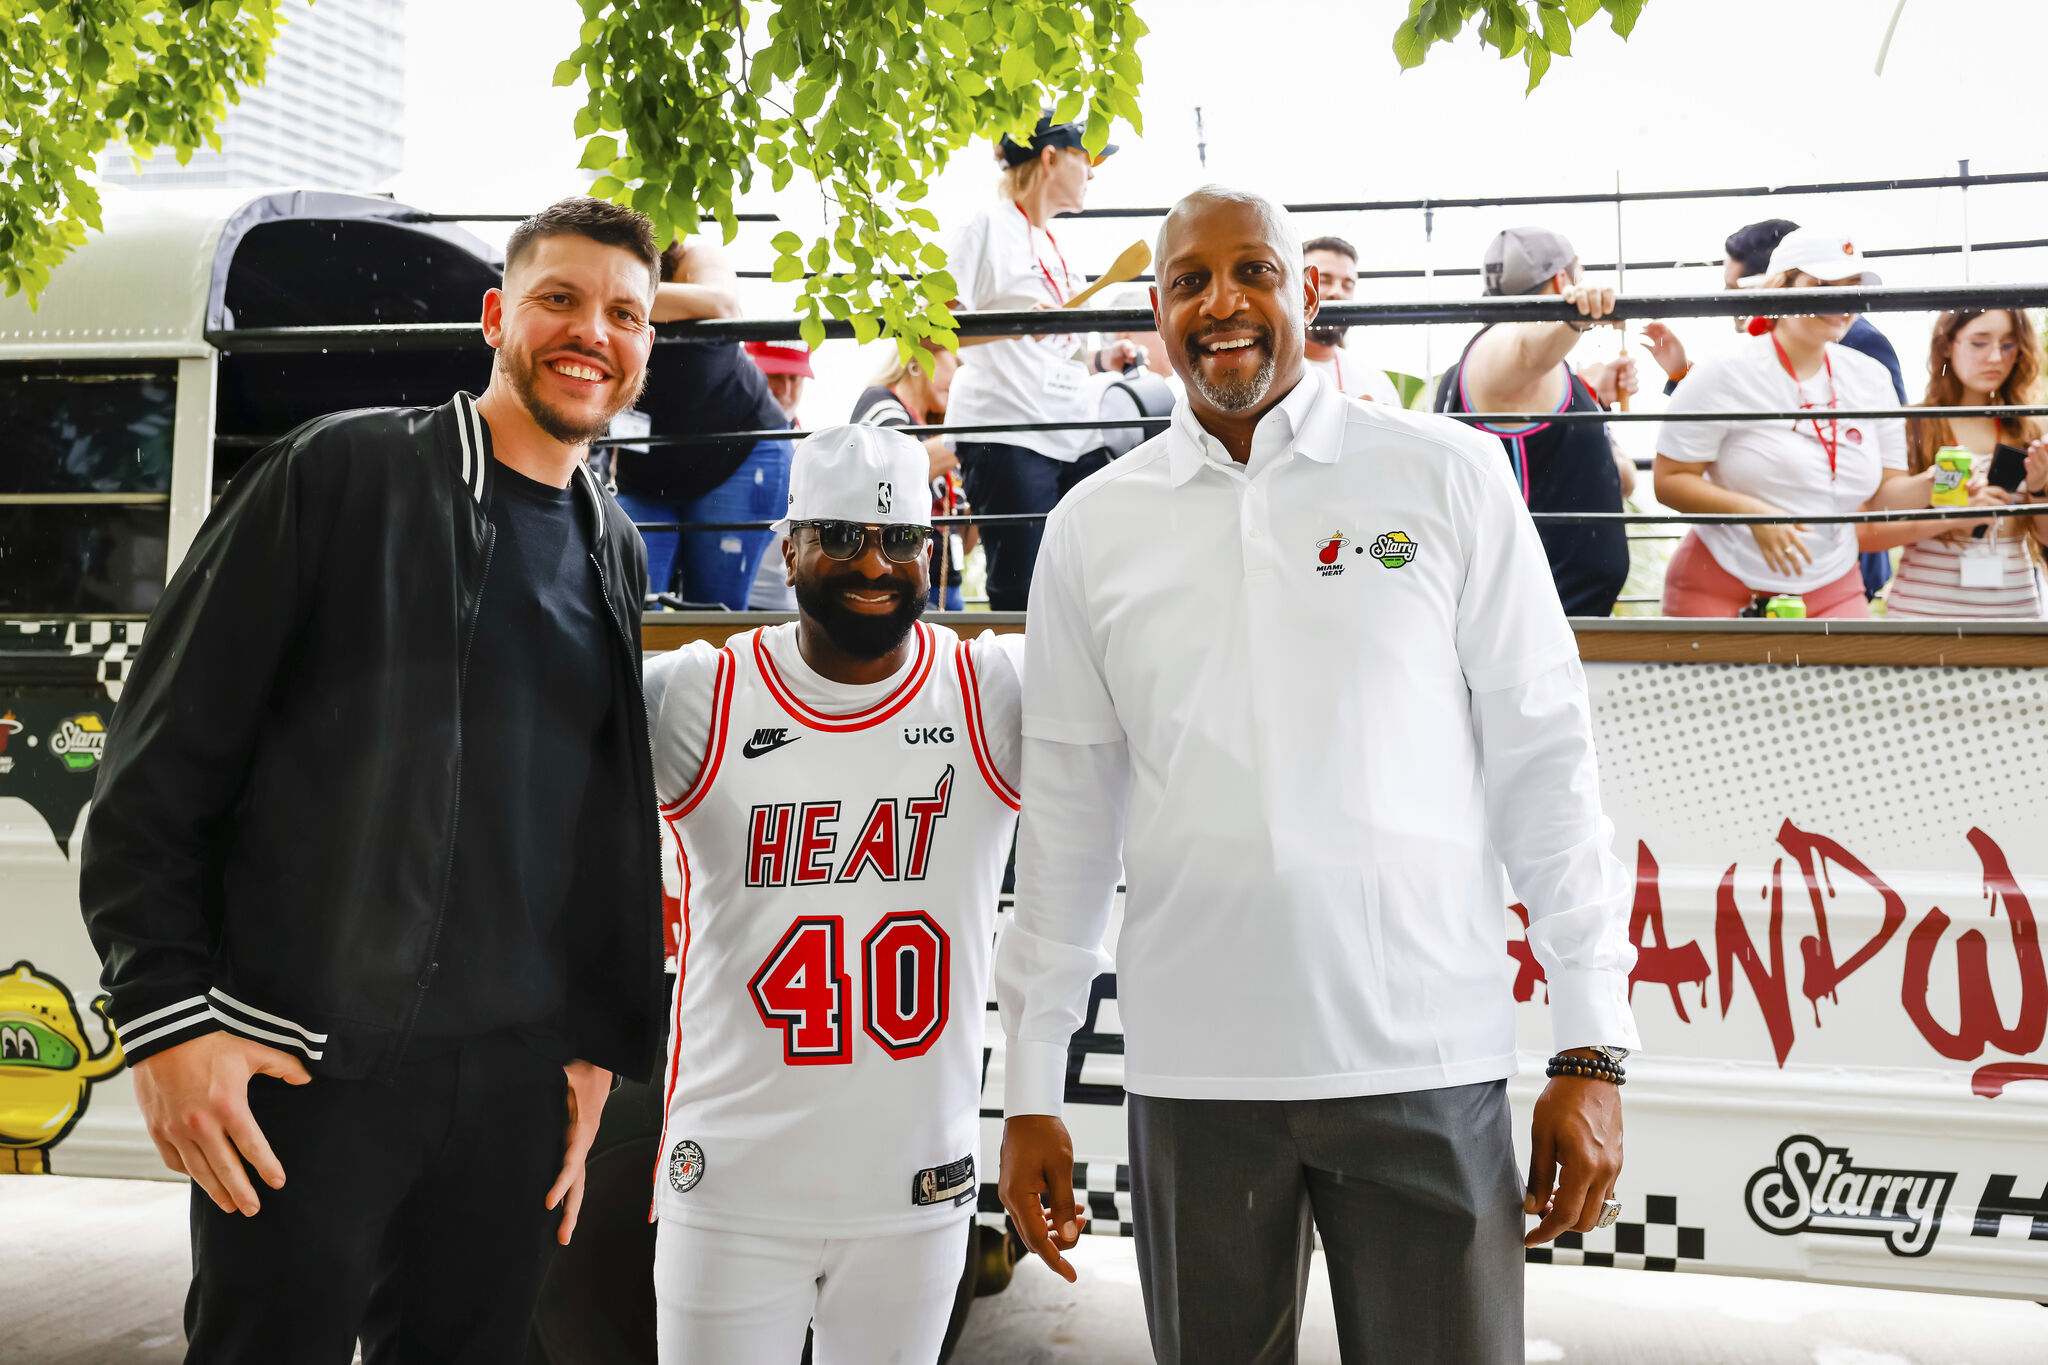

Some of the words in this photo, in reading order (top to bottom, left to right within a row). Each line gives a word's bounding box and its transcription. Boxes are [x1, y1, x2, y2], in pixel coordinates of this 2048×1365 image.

[1316, 564, 1344, 572] MIAMI
[1321, 567, 1346, 577] HEAT
[1370, 534, 1418, 562] Starry
[751, 728, 789, 746] NIKE
[745, 763, 955, 888] HEAT
[1507, 817, 2048, 1069] ANDW
[746, 909, 951, 1066] 40
[1744, 1134, 1959, 1258] Starry
